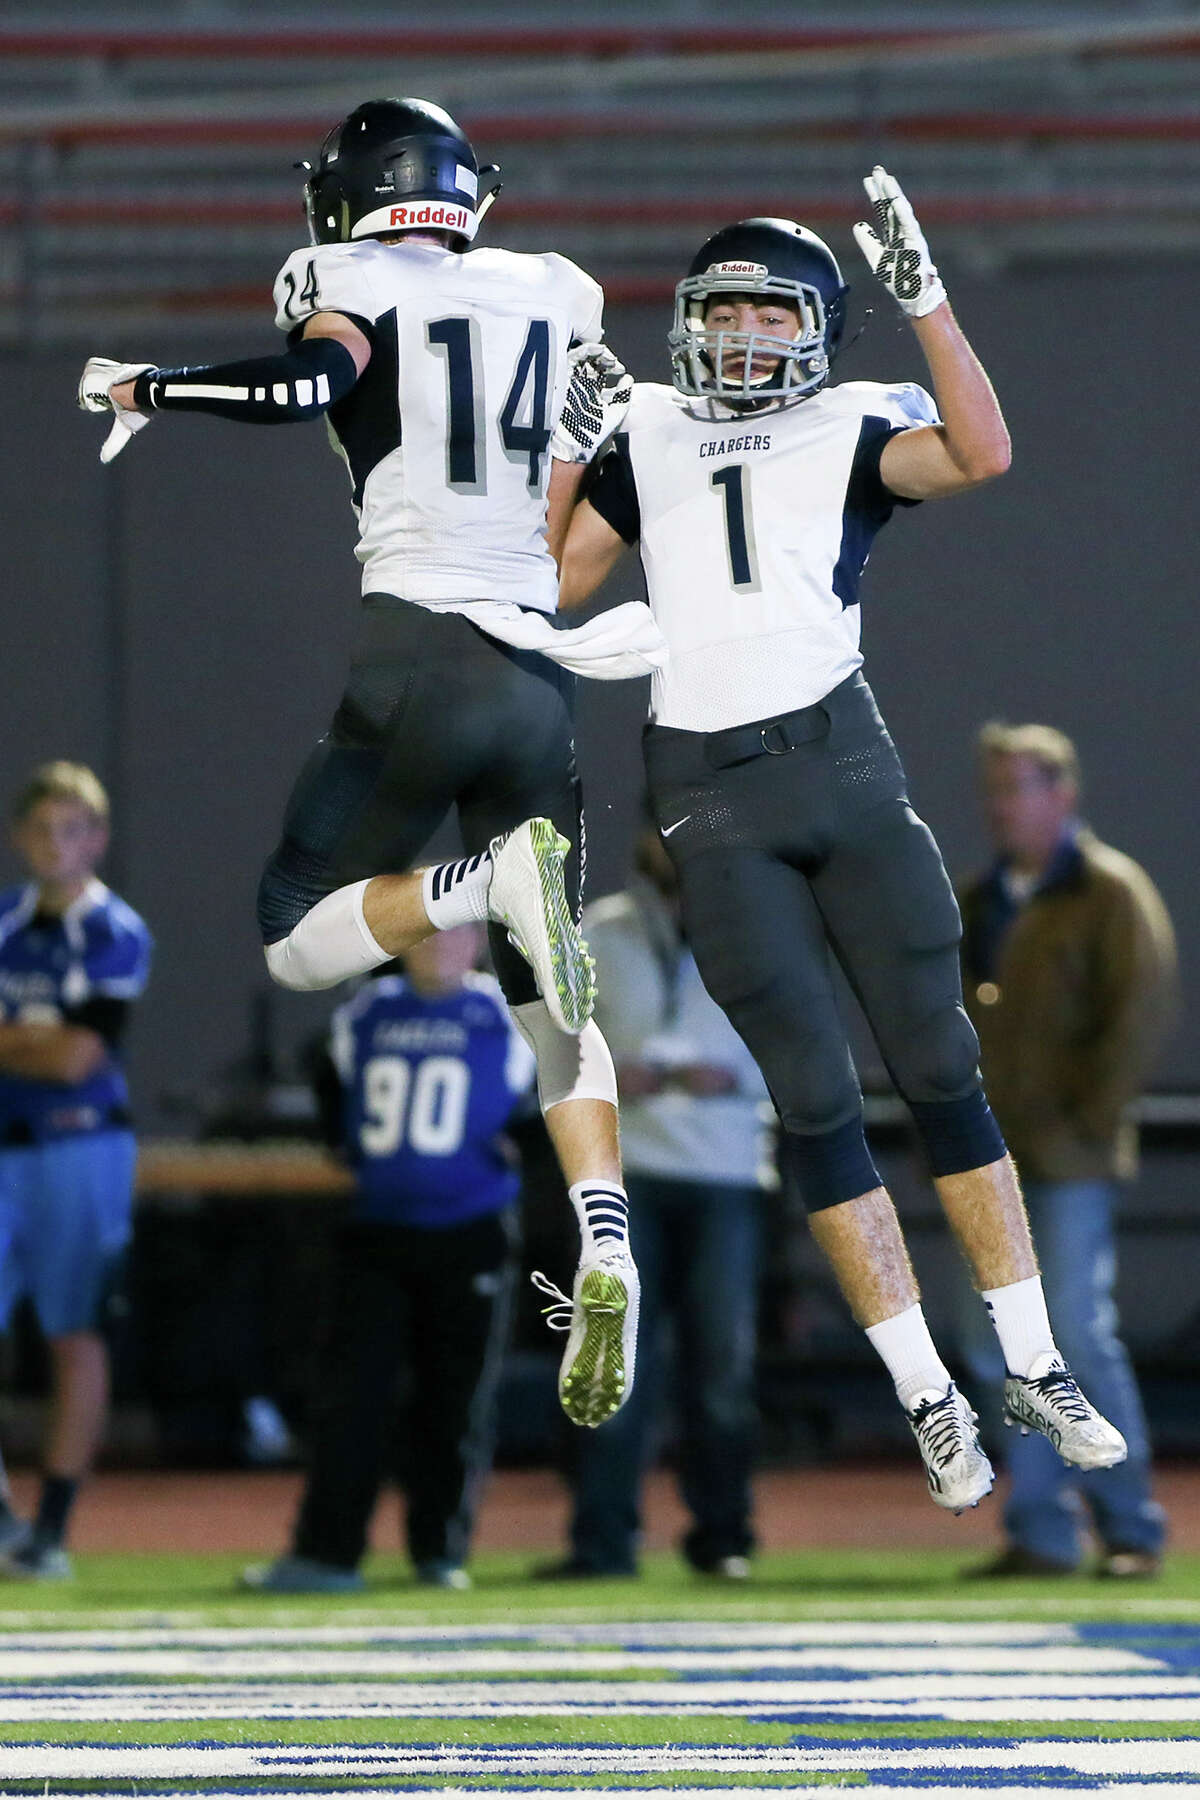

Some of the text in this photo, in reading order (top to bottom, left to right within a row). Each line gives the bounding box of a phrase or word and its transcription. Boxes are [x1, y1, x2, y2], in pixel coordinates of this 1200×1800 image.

[390, 207, 468, 229] Riddell
[721, 264, 755, 272] Riddell
[425, 314, 559, 498] 14
[699, 435, 771, 458] CHARGERS
[709, 462, 762, 594] 1
[359, 1055, 470, 1158] 90
